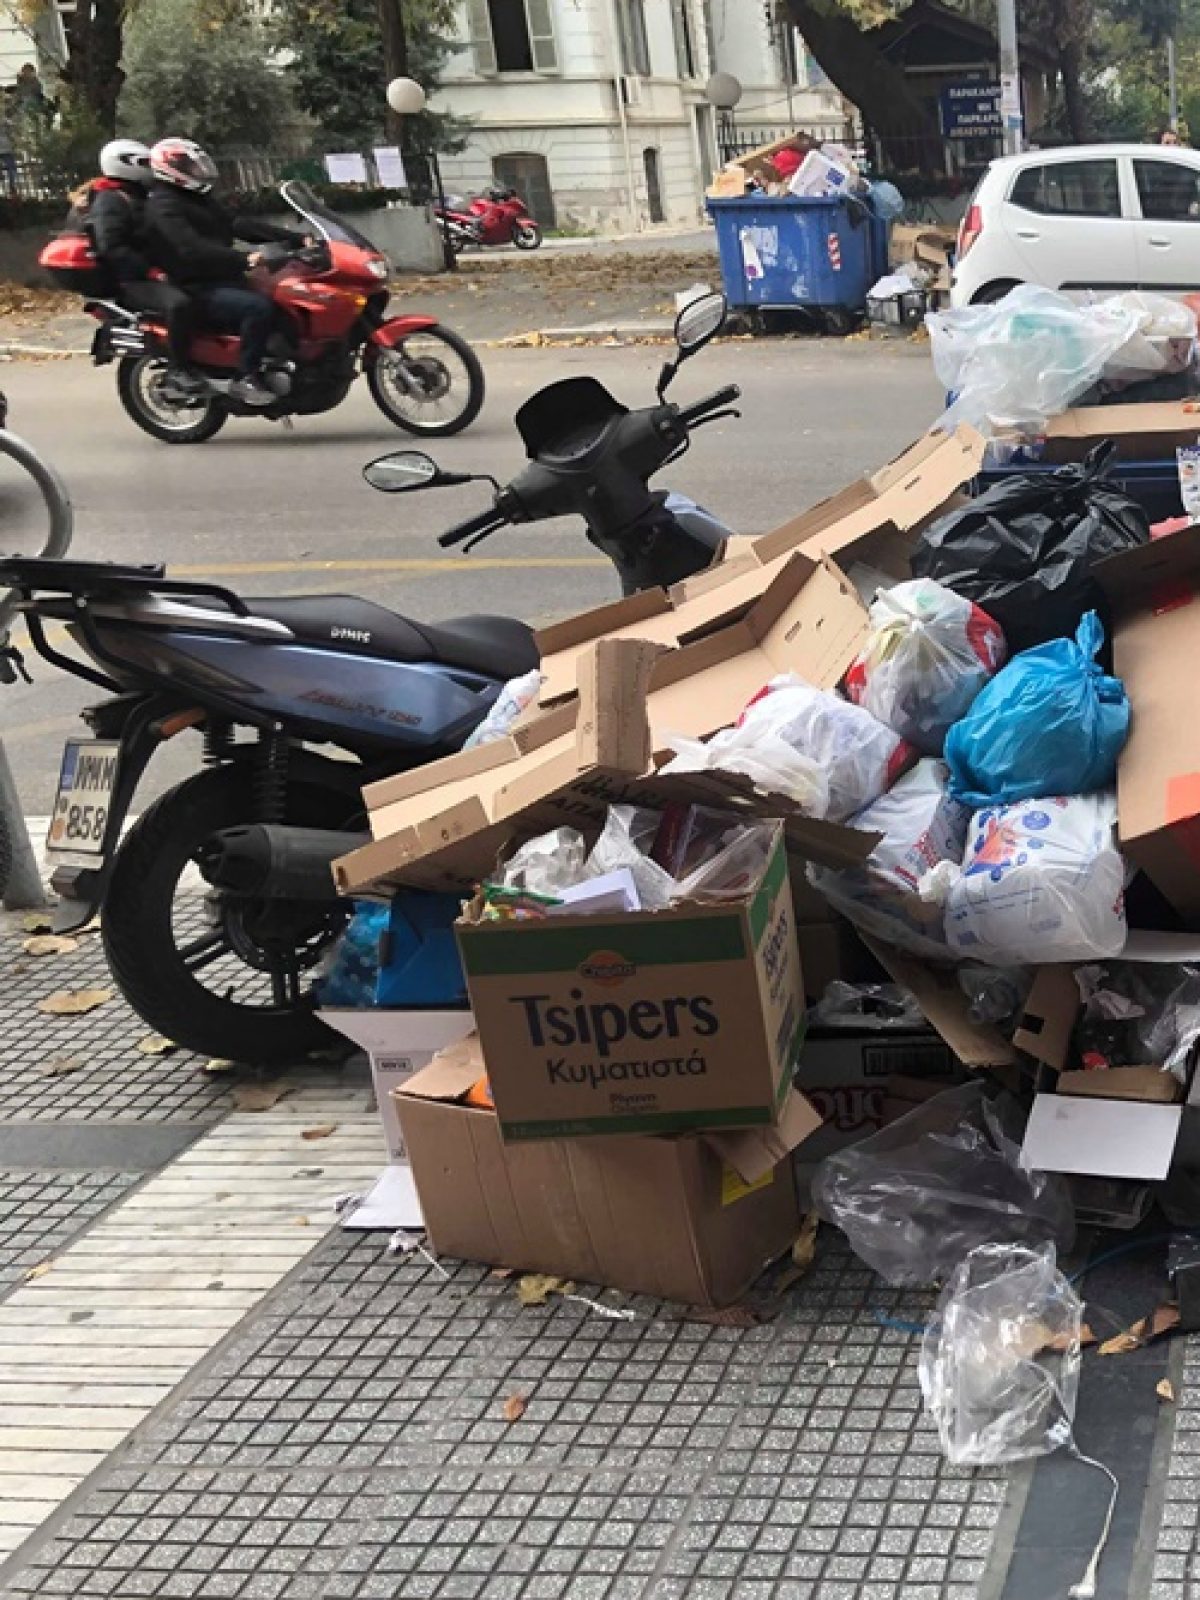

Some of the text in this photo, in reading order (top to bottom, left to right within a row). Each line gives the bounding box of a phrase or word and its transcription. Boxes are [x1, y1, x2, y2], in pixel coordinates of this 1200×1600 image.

[67, 805, 107, 841] 858
[507, 987, 720, 1058] Tsipers
[546, 1047, 708, 1090] Κυματιστά
